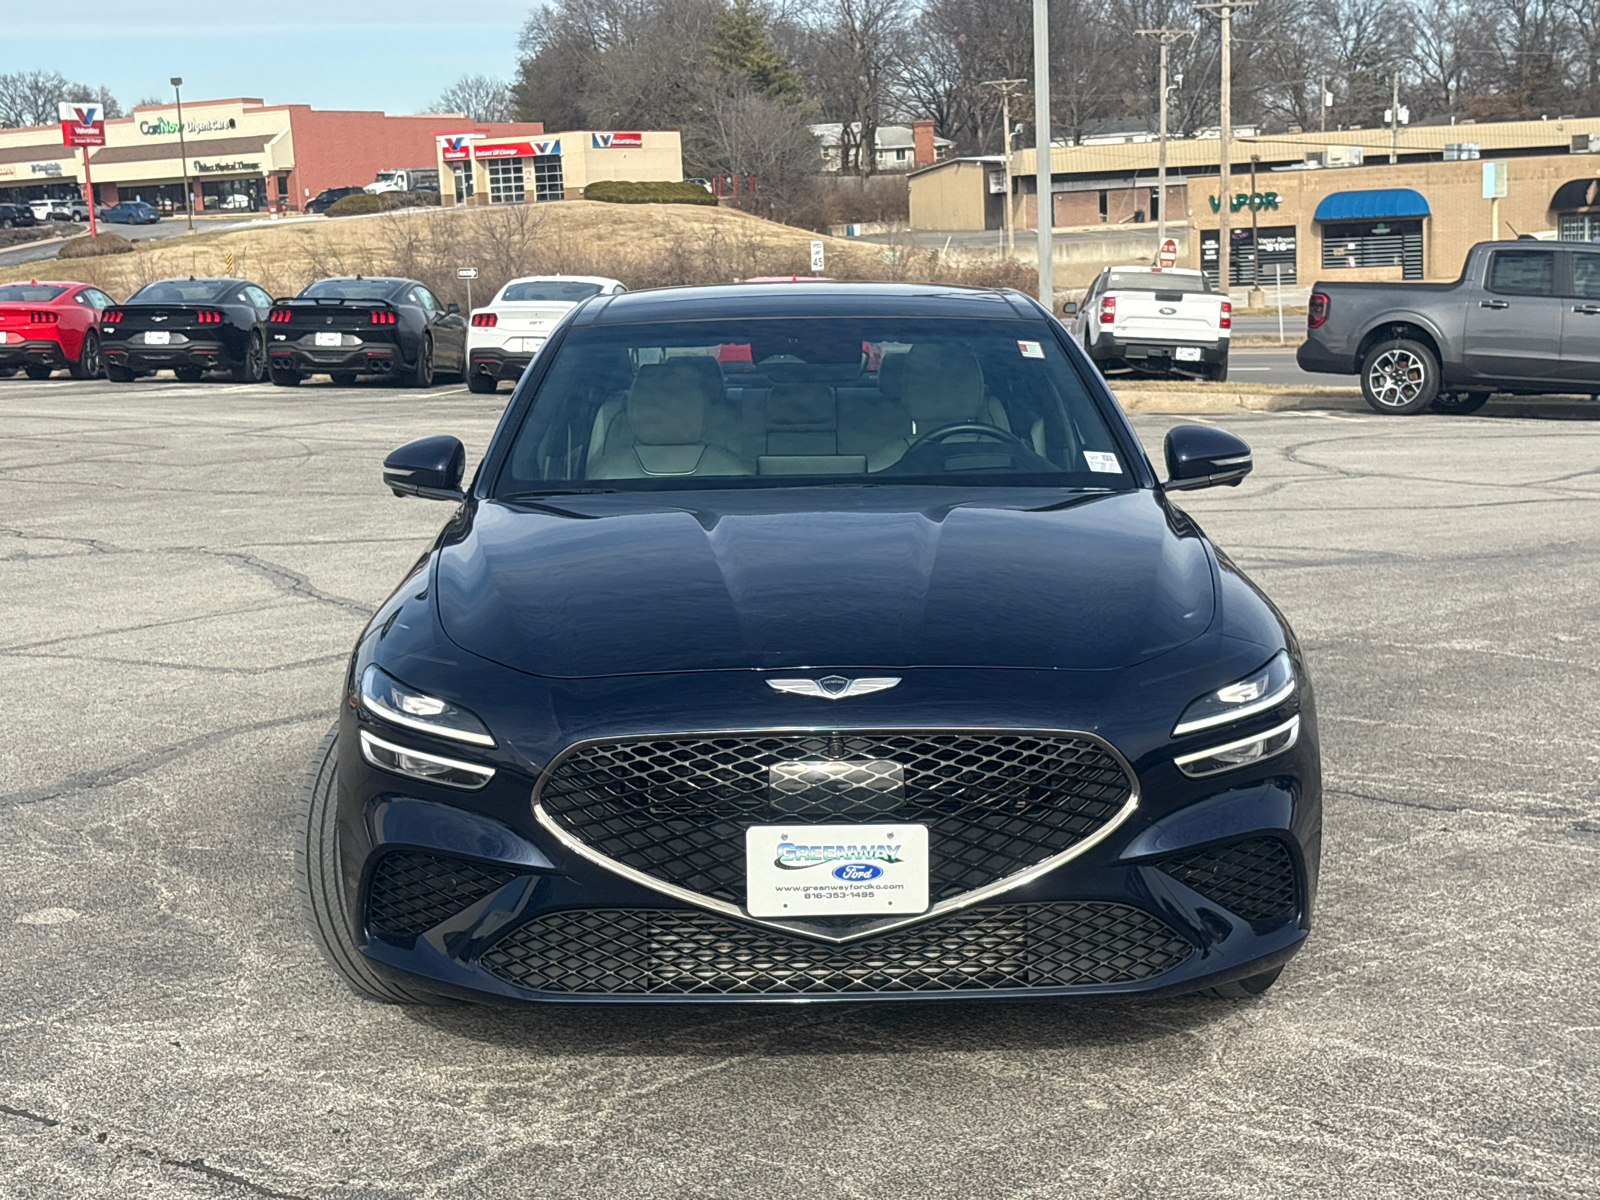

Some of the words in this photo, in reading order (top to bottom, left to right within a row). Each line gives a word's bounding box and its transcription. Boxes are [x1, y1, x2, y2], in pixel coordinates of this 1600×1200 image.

[500, 148, 518, 156] Change
[813, 257, 823, 267] 45
[776, 842, 902, 862] GREENWAY
[841, 865, 873, 880] Ford
[774, 883, 904, 892] www.greenwayfordkc.com
[804, 892, 875, 900] 816-353-1495
